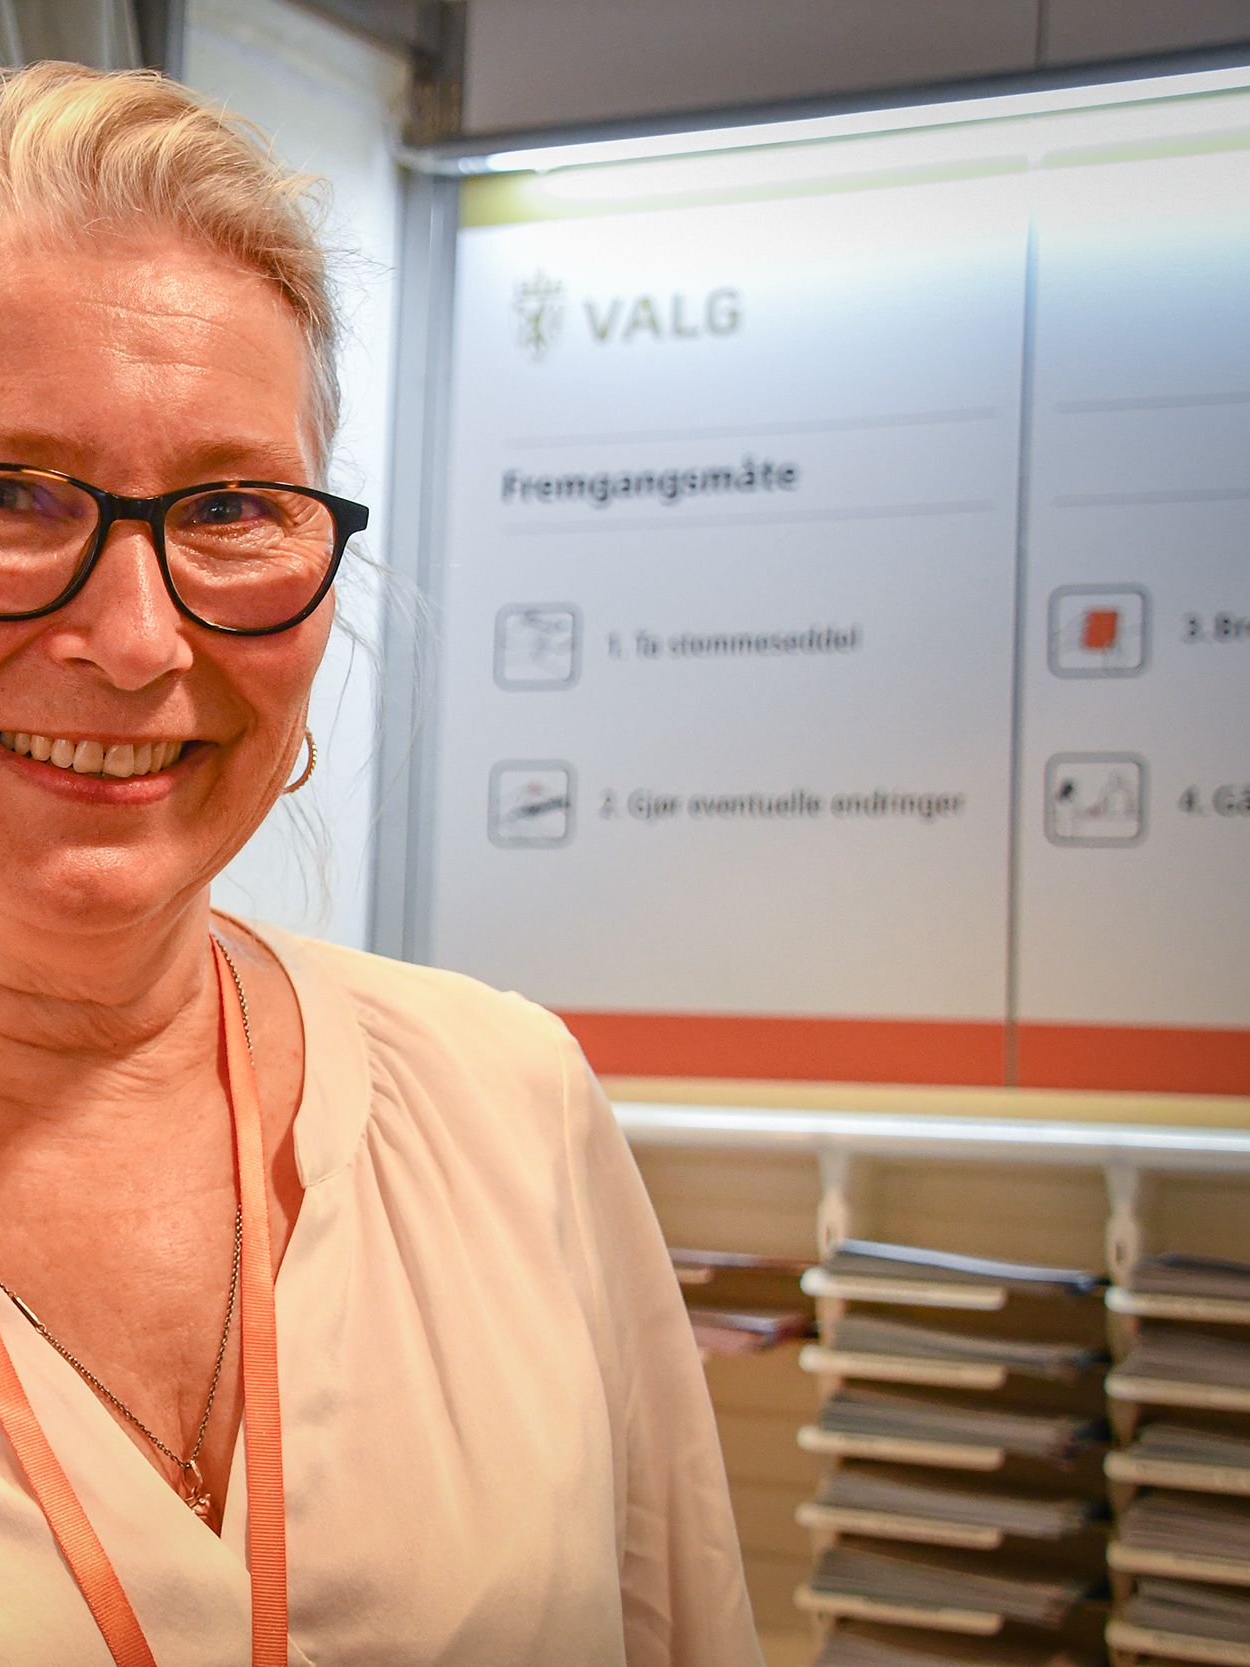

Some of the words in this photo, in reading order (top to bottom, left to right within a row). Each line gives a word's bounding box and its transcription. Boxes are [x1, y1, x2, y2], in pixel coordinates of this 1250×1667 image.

[583, 286, 743, 346] VALG
[501, 453, 802, 508] Fremgangsmåte
[1181, 610, 1212, 646] 3.
